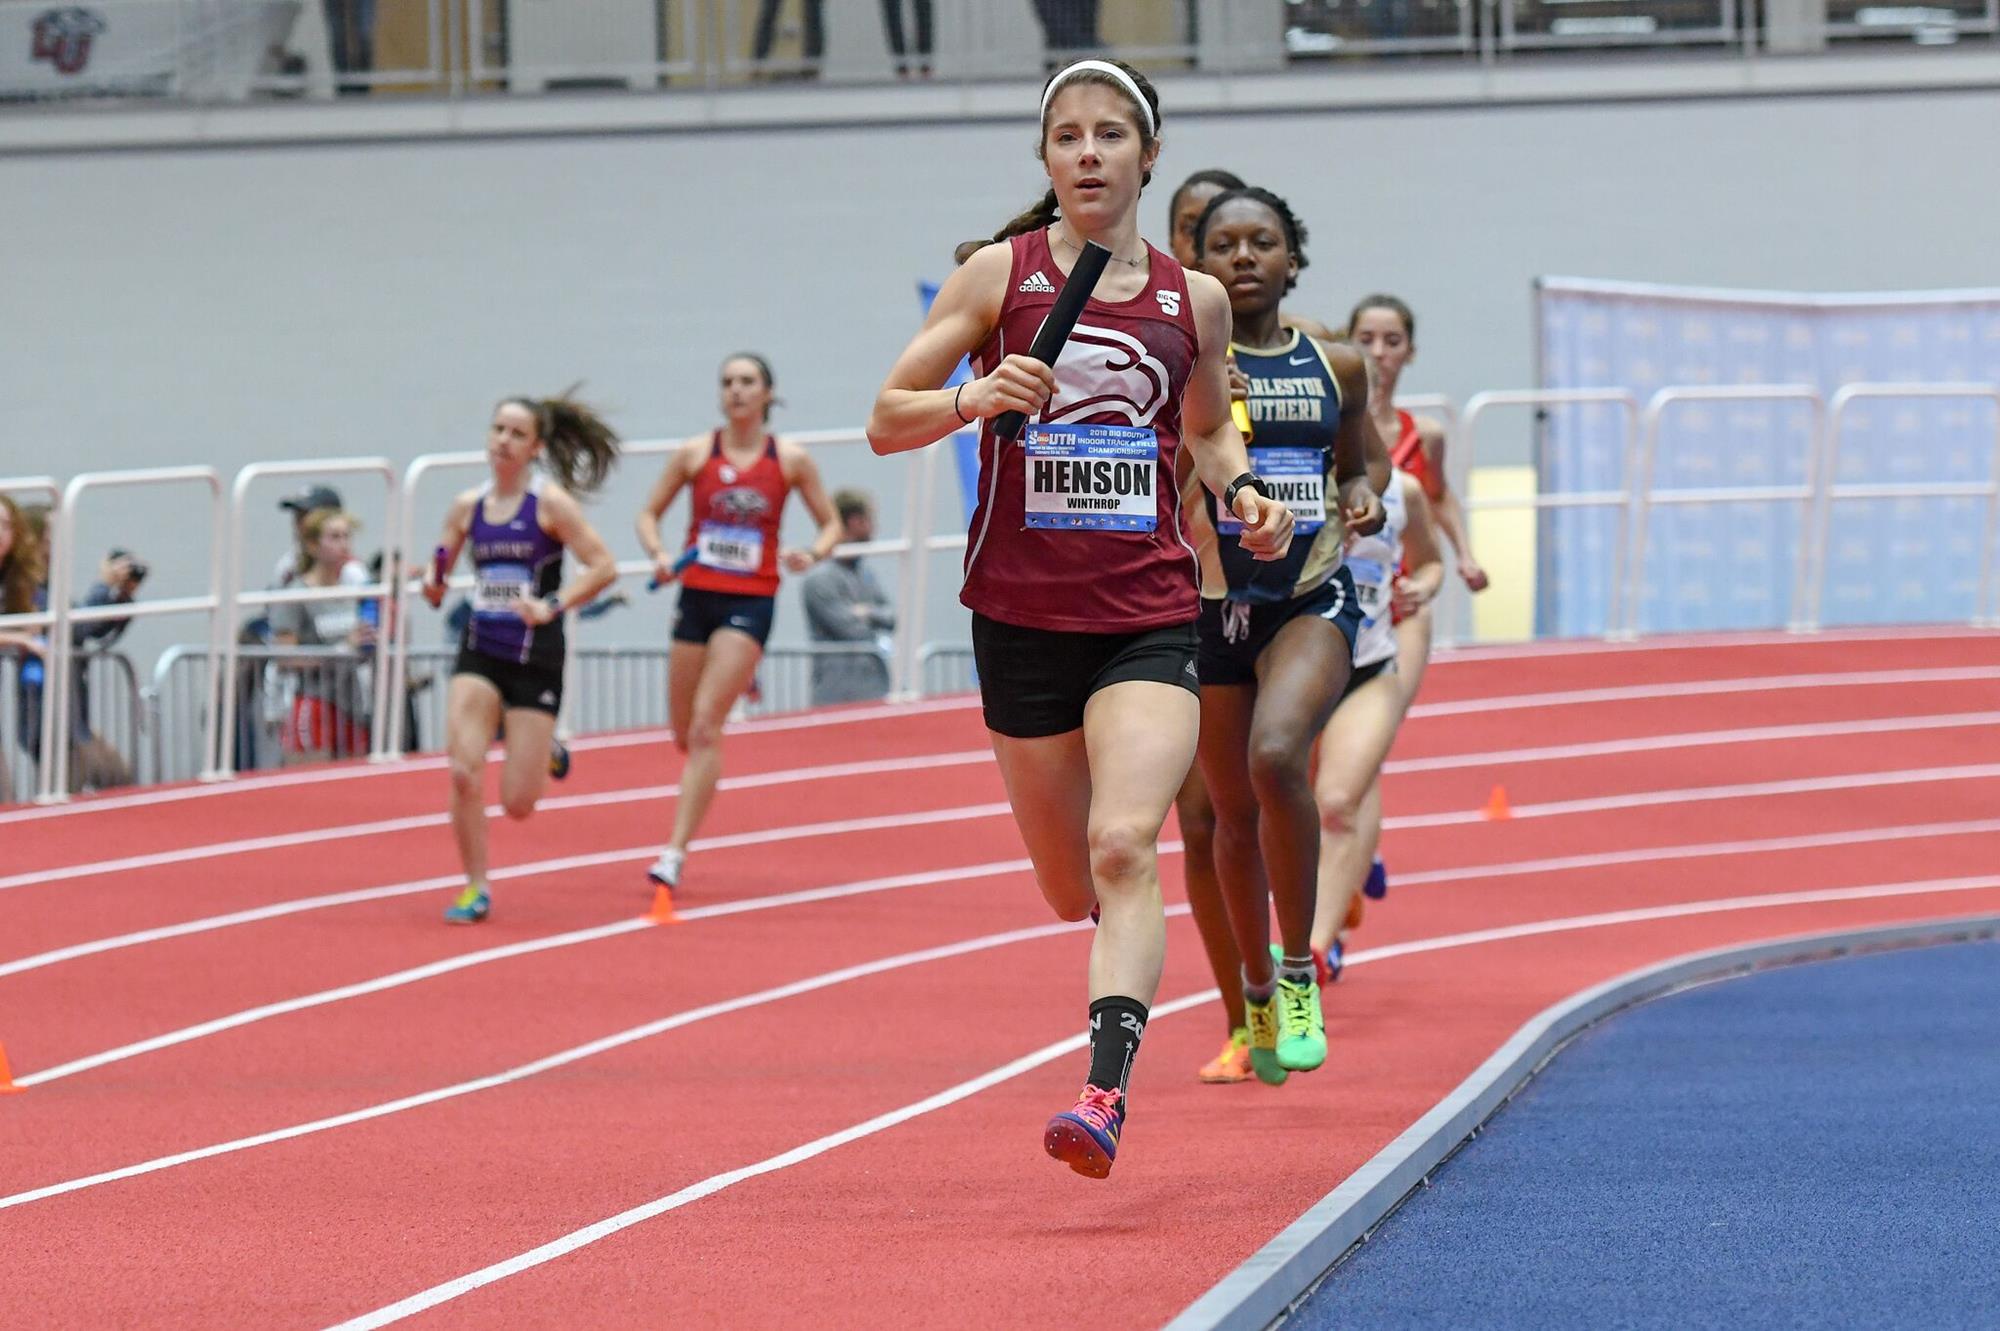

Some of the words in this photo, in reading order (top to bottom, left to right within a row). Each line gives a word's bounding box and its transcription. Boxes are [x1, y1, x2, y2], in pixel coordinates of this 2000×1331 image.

[1019, 283, 1056, 293] adidas
[1248, 377, 1326, 397] RLESTON
[1247, 398, 1322, 421] UTHERN
[1122, 431, 1145, 439] SOUTH
[1077, 437, 1105, 446] INDOOR
[1107, 439, 1130, 447] TRACK
[1136, 440, 1157, 448] FIELD
[1087, 446, 1147, 456] CHAMPIONSHIPS
[1034, 460, 1150, 496] HENSON
[1265, 482, 1320, 501] OWELL
[1067, 498, 1120, 510] WINTHROP
